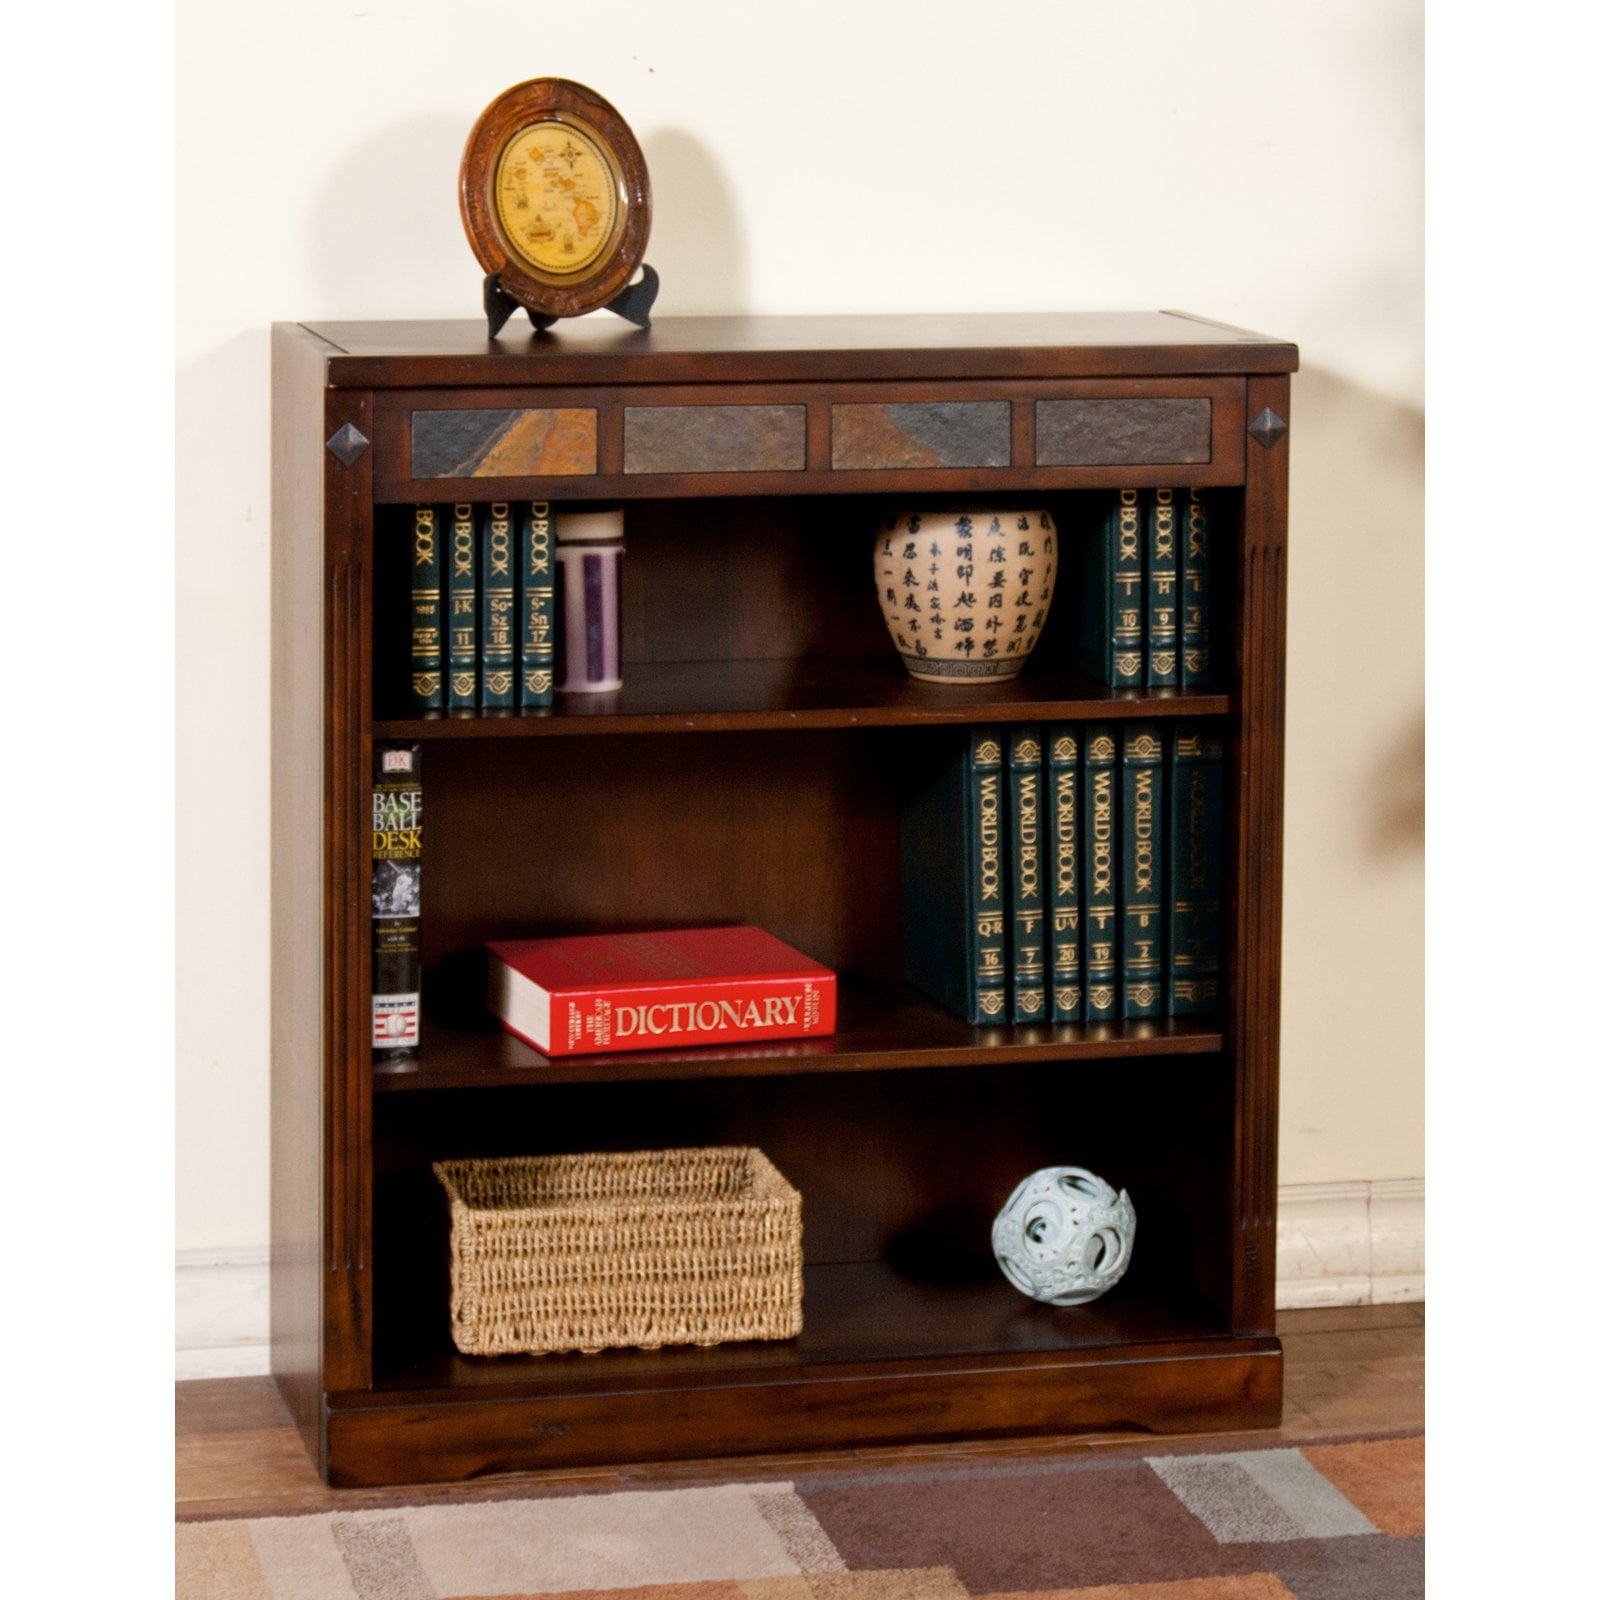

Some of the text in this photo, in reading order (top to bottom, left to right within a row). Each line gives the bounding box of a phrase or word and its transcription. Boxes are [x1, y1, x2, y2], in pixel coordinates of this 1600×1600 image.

[416, 509, 434, 566] BOOK
[1120, 507, 1137, 561] BOOK
[1156, 506, 1173, 560] BOOK
[454, 522, 472, 577] BOOK
[491, 521, 509, 576] BOOK
[531, 520, 549, 575] BOOK
[1158, 581, 1170, 594] H
[491, 614, 508, 626] Sz
[530, 612, 548, 625] Sn
[1122, 614, 1137, 627] 10
[1159, 613, 1169, 626] 9
[456, 632, 469, 645] 11
[491, 631, 507, 644] 18
[531, 630, 547, 643] 17
[388, 751, 407, 768] DK
[372, 791, 422, 813] BASE
[372, 811, 422, 832] BALL
[980, 775, 999, 900] WORLD BOOK
[1020, 773, 1038, 899] WORLD BOOK
[1057, 772, 1075, 896] WORLD BOOK
[1094, 770, 1111, 895] WORLD BOOK
[1135, 769, 1152, 894] WORLD BOOK
[372, 829, 422, 851] DESK
[1025, 922, 1034, 934] F
[1098, 916, 1107, 930] T
[1139, 915, 1149, 928] B
[984, 953, 998, 966] 16
[1026, 951, 1035, 964] 7
[1060, 950, 1075, 962] 20
[1095, 948, 1110, 961] 19
[1140, 946, 1149, 958] 2
[615, 996, 803, 1037] DICTIONARY
